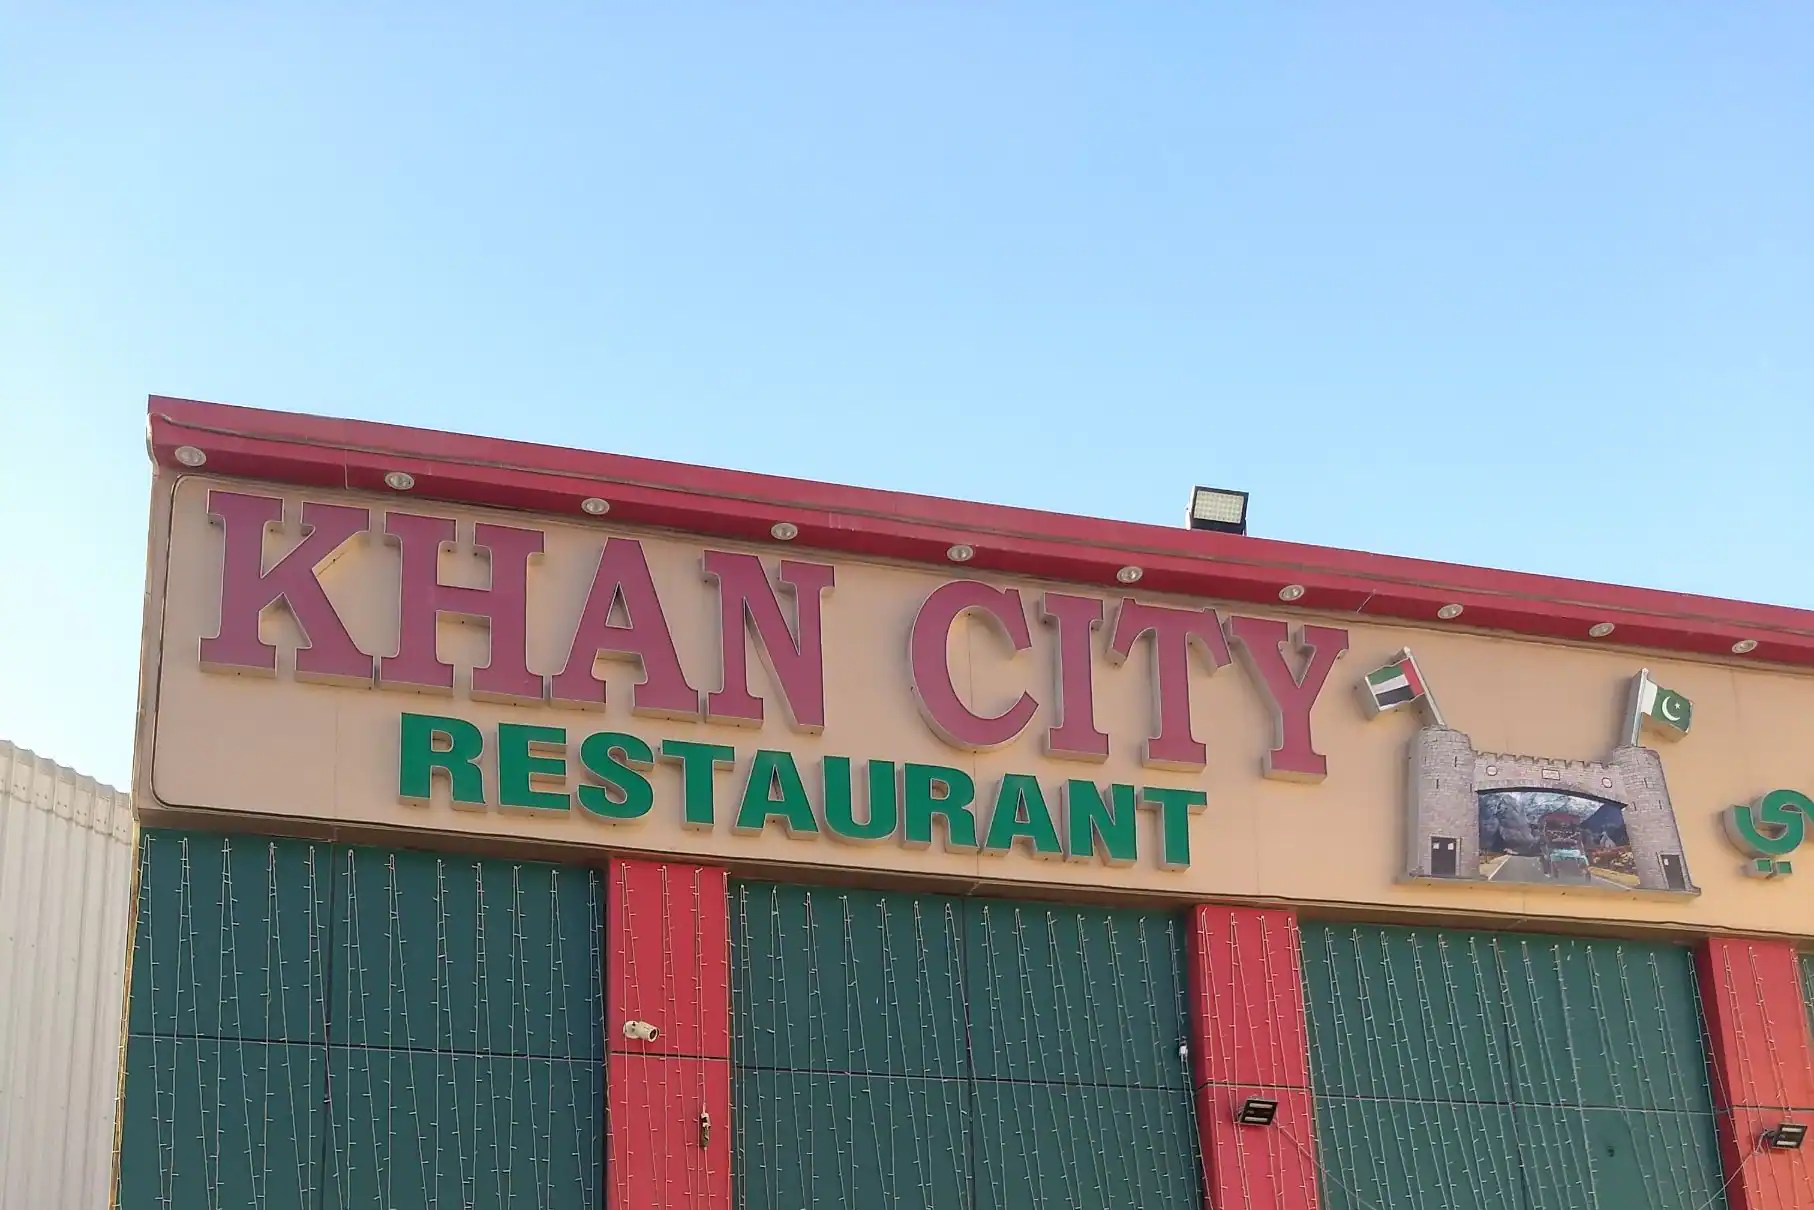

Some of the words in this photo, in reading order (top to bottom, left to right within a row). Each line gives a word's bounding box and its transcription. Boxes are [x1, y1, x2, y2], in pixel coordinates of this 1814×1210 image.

[199, 489, 836, 733] KHAN
[909, 579, 1349, 782] CITY
[400, 712, 1208, 870] RESTAURANT
